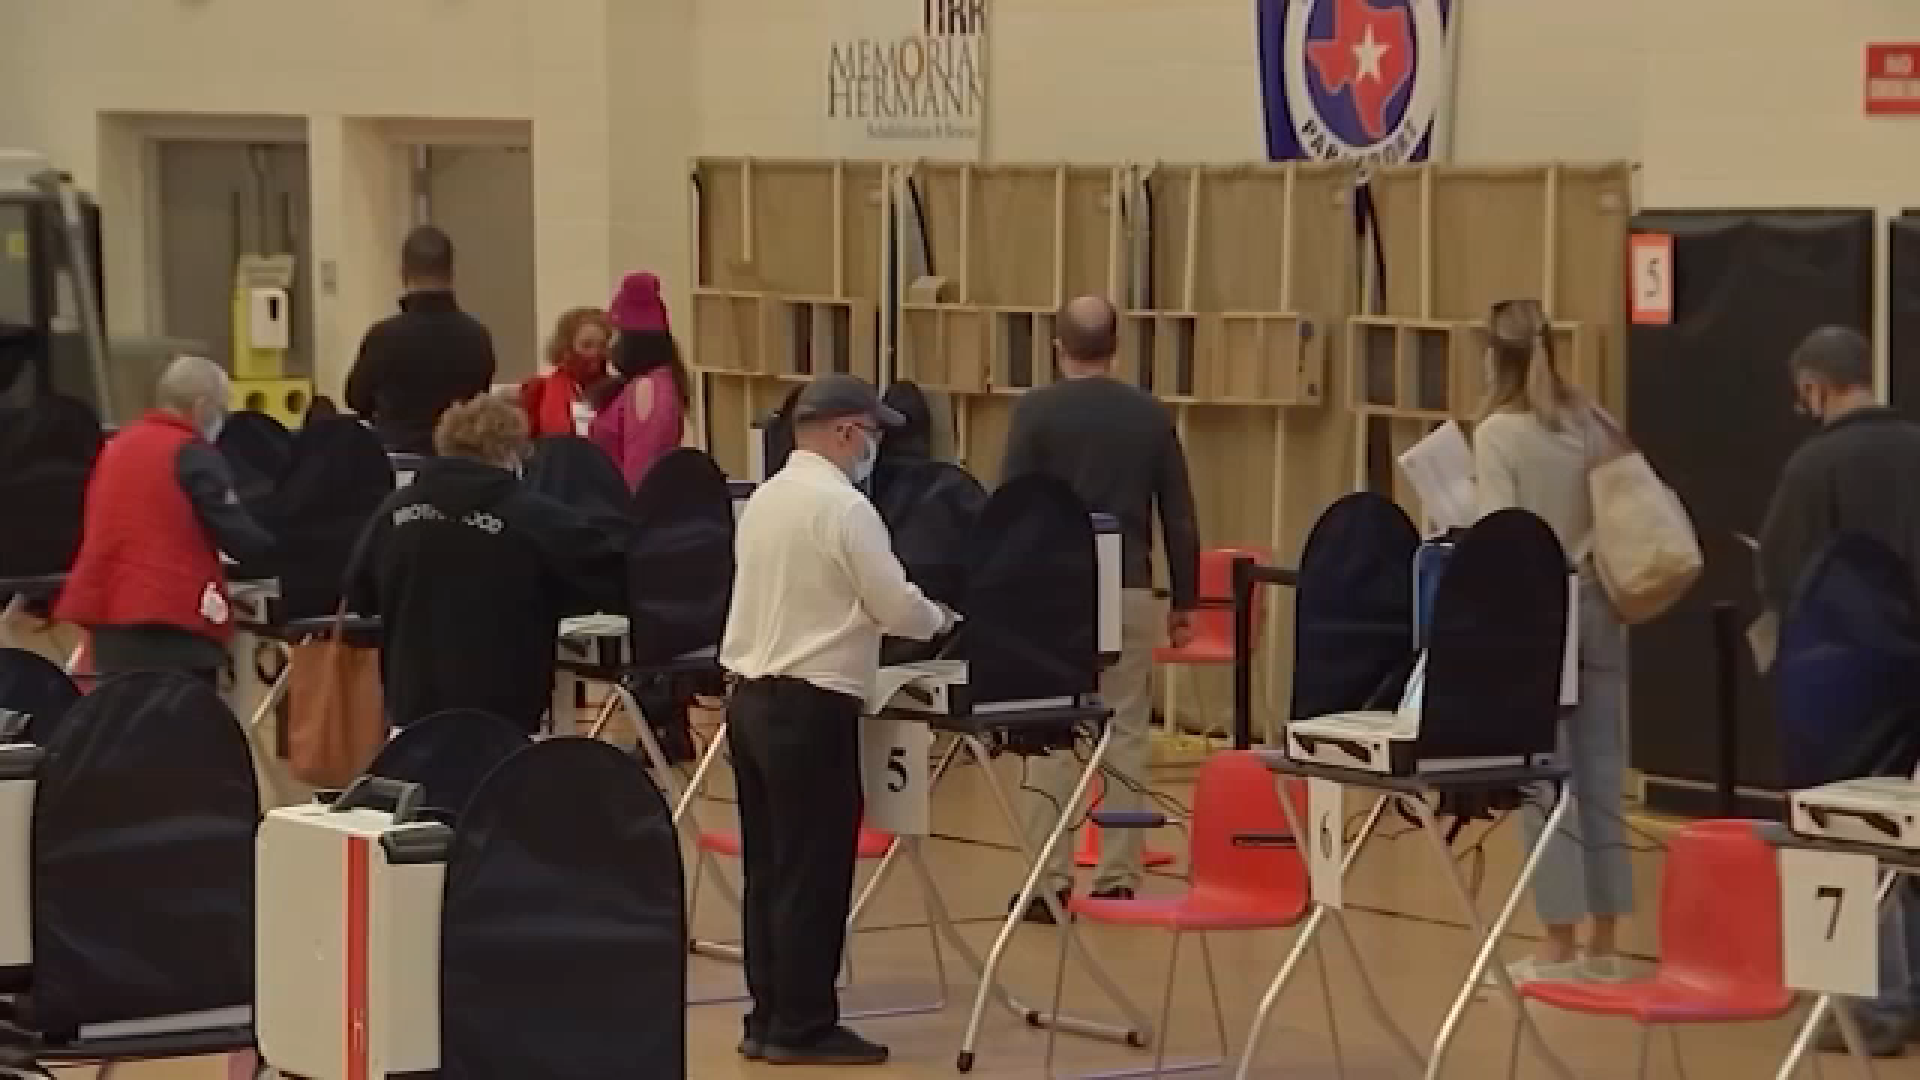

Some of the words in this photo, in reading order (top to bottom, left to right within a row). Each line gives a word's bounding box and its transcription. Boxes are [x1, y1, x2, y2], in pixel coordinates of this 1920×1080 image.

[1644, 257, 1662, 297] 5
[887, 746, 907, 792] 5
[1320, 810, 1333, 861] 6
[1815, 885, 1845, 940] 7
